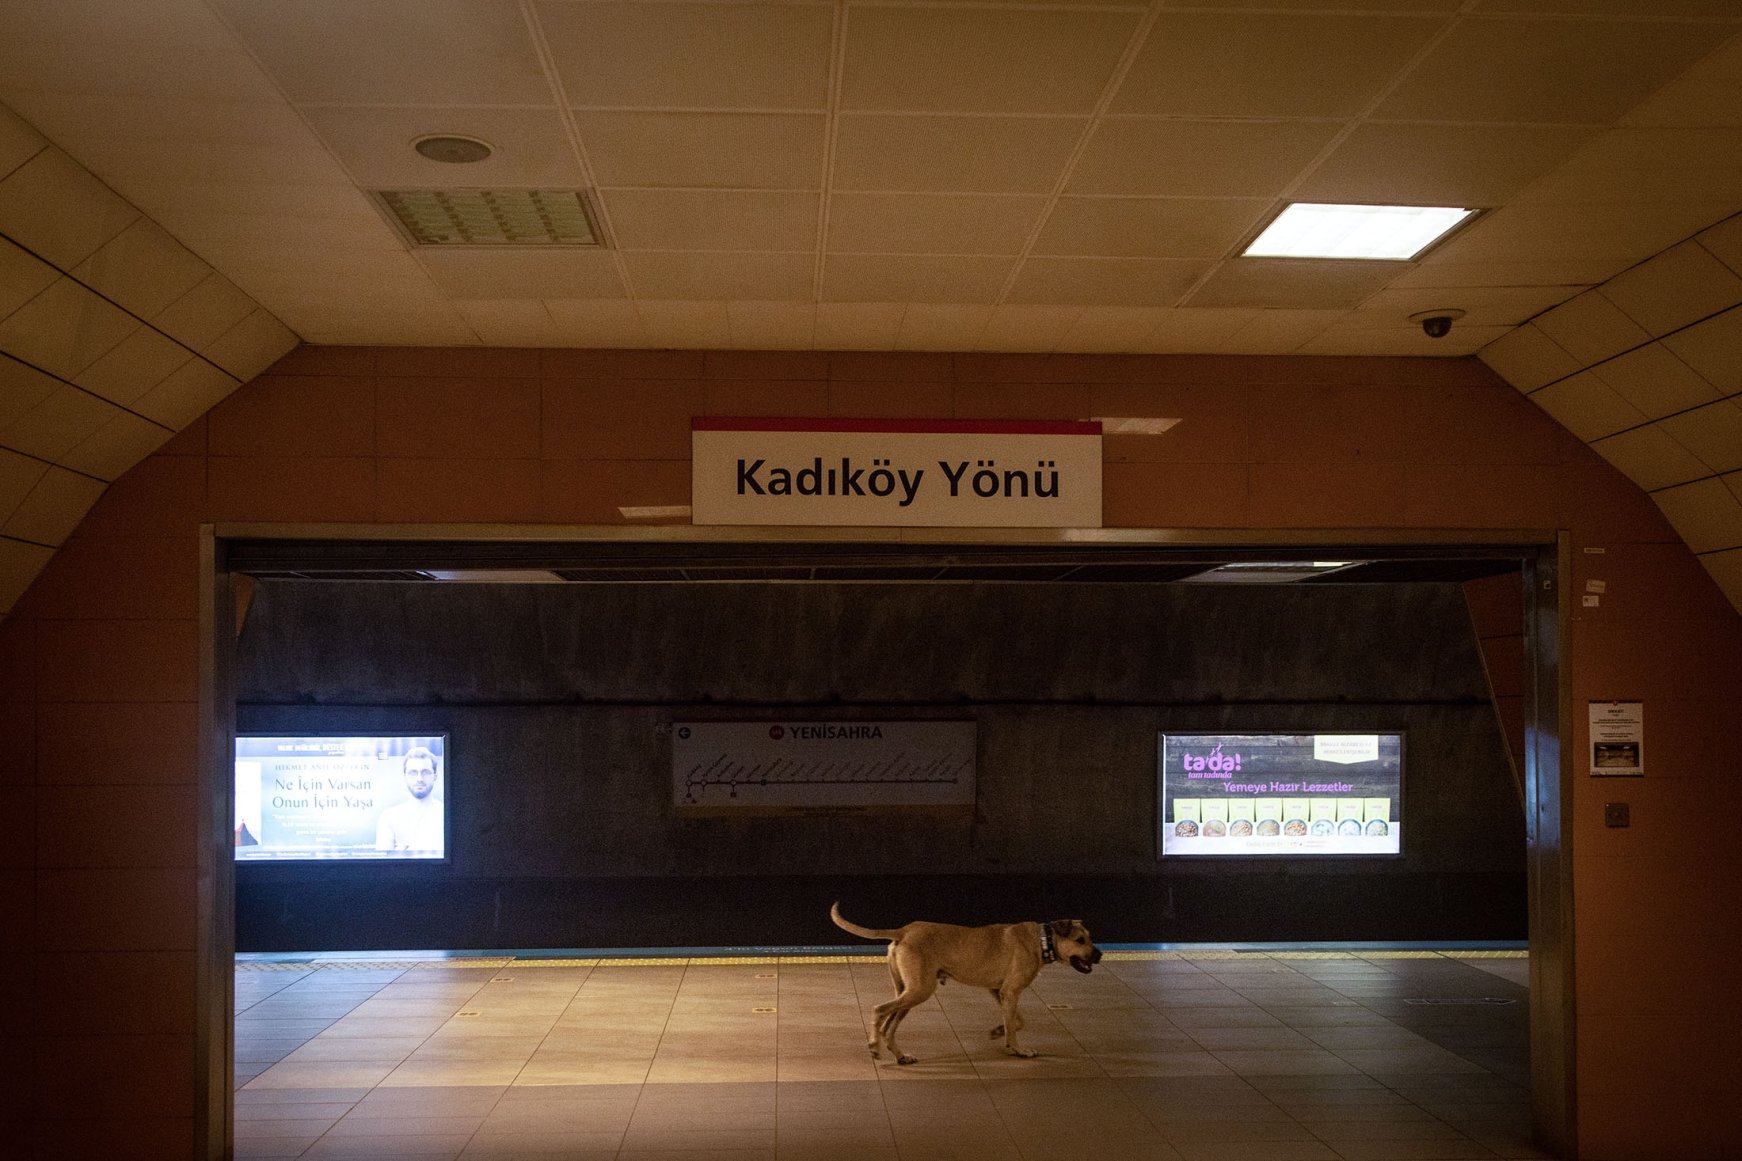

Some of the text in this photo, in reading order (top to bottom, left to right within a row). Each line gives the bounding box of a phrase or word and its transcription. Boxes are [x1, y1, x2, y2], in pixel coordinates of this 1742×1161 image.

[736, 458, 1060, 507] Kadıköy Yönü
[790, 723, 883, 739] YENİSAHRA
[274, 775, 371, 793] Ne İçin Varsan
[1223, 781, 1354, 794] Yemeye Hazır Lezzetler
[272, 793, 374, 811] Onun İçin Yaşa
